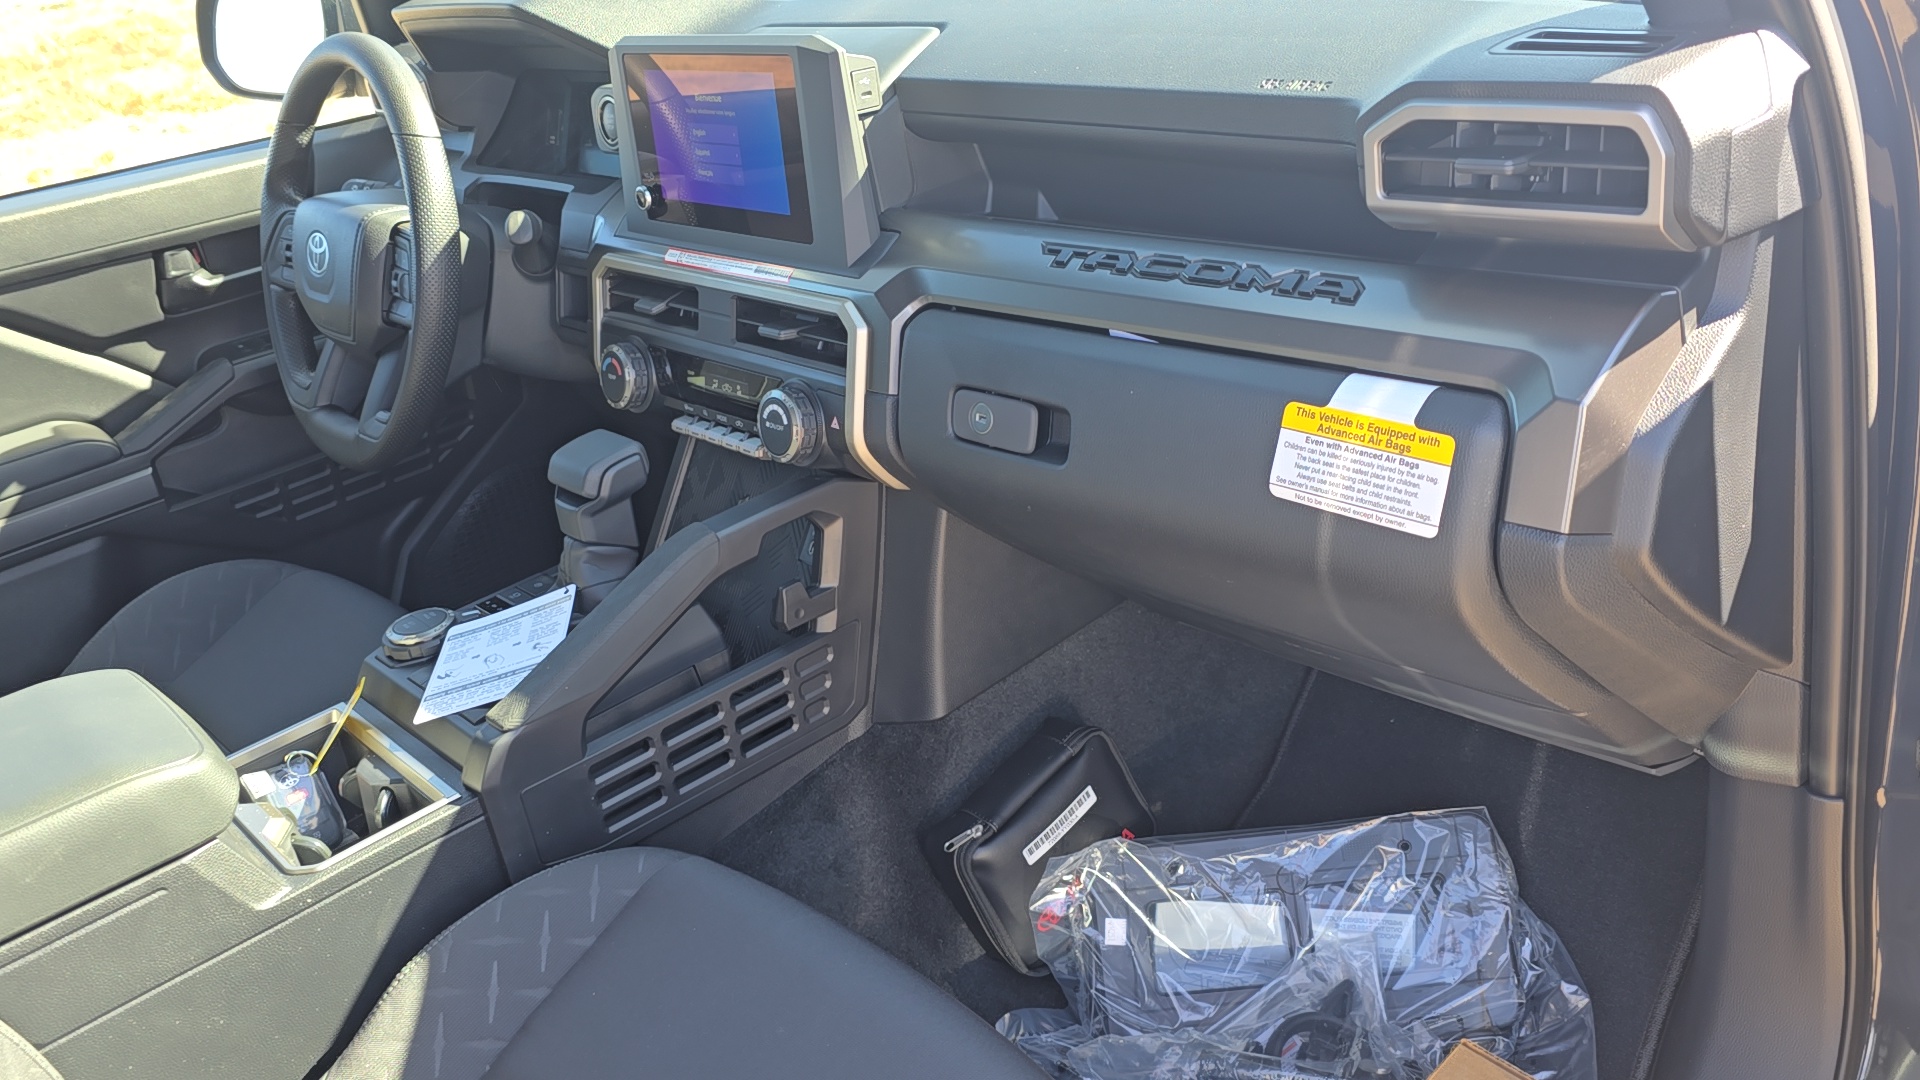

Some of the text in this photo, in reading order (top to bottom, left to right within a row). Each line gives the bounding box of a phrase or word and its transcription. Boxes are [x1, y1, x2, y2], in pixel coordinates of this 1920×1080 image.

[1041, 240, 1366, 306] TACOMA
[1296, 407, 1440, 447] This Vehicle is Equipped with
[1317, 424, 1411, 453] Advanced Air Bags
[1284, 441, 1306, 452] Children
[1327, 452, 1342, 460] killed
[1350, 458, 1375, 469] seriously
[1376, 463, 1396, 473] injured
[1398, 469, 1404, 477] by
[1297, 453, 1307, 461] The
[1308, 456, 1320, 464] back
[1322, 460, 1334, 468] seat
[1352, 467, 1369, 476] safest
[1370, 472, 1386, 480] place
[1305, 436, 1419, 470] Even with Advanced Air Bags
[1294, 462, 1310, 470] Never
[1358, 478, 1371, 486] child
[1373, 482, 1385, 490] seat
[1297, 472, 1315, 482] Always
[1342, 483, 1355, 492] belts
[1369, 490, 1383, 499] child
[1276, 476, 1286, 484] See
[1309, 485, 1330, 494] manual
[1355, 496, 1387, 509] information
[1389, 505, 1405, 514] about
[1295, 493, 1306, 501] Not
[1324, 502, 1351, 513] removed
[1353, 510, 1373, 519] except
[1375, 515, 1383, 523] by
[1385, 518, 1406, 528] owner.
